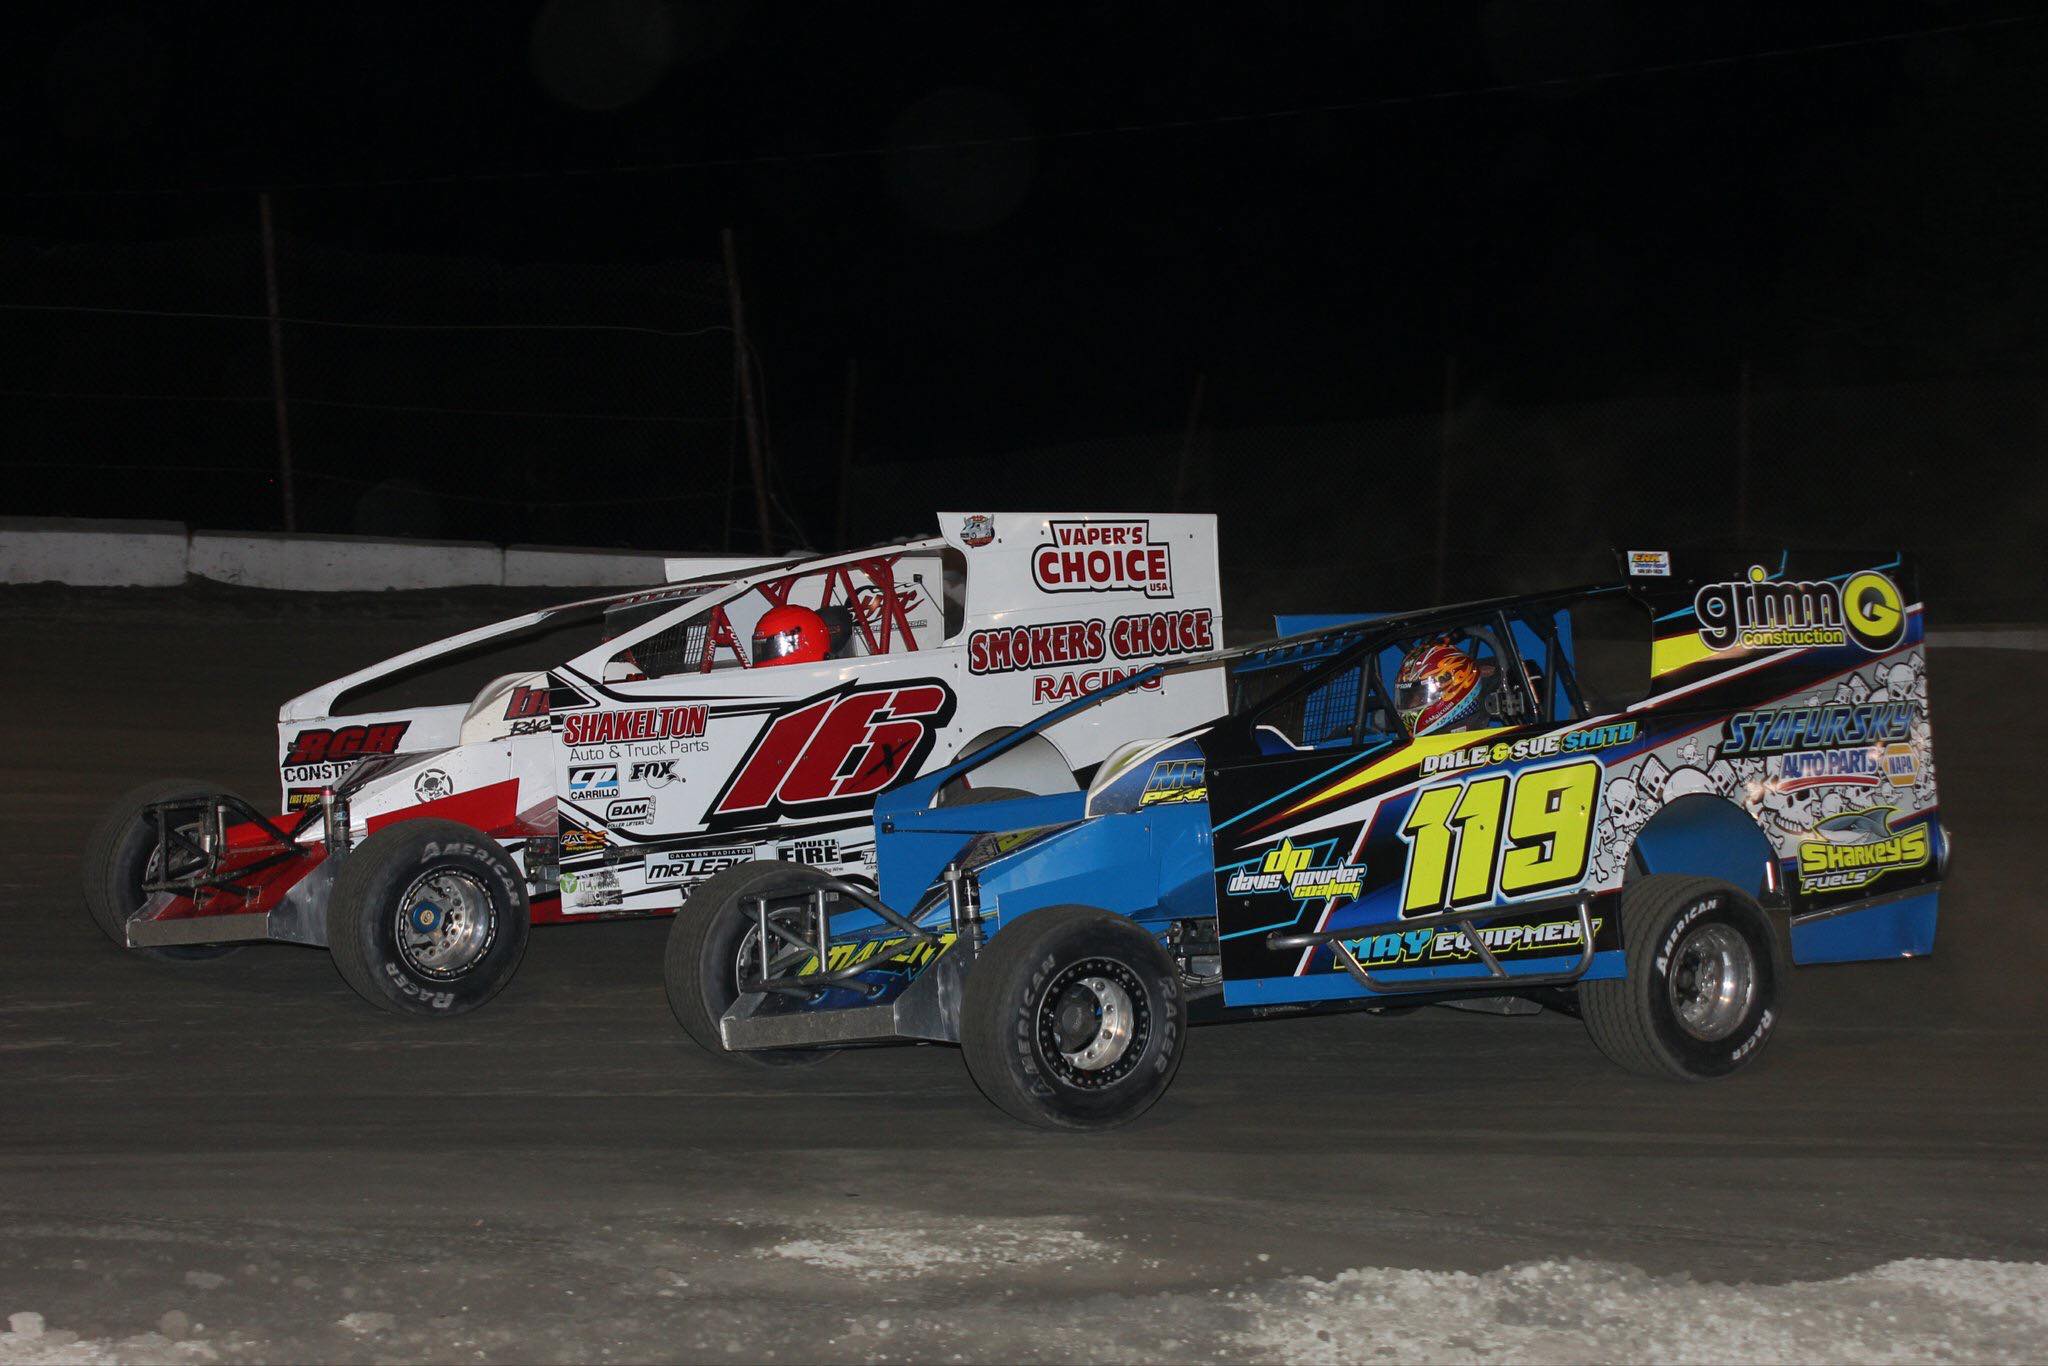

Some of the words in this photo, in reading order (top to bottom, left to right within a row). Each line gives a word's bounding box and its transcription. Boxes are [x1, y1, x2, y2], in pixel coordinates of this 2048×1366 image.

[1059, 526, 1142, 546] VAPER'S
[1038, 549, 1167, 584] CHOICE
[1150, 582, 1168, 592] USA
[970, 620, 1105, 674] SMOKERS
[1112, 610, 1212, 657] CHOICE
[1742, 629, 1845, 647] construction
[1034, 665, 1162, 702] RACING
[563, 704, 709, 746] SHAKELTON
[1722, 702, 1918, 752] STAFURSKY
[570, 748, 604, 761] Auto
[609, 745, 621, 759] &
[625, 742, 666, 757] Truck
[670, 740, 709, 753] Parts
[1421, 746, 1489, 775] DALE
[1491, 743, 1511, 763] &
[1511, 736, 1561, 759] SUE
[1562, 723, 1637, 750] SMITH
[1781, 751, 1824, 778] AUTO
[1827, 748, 1877, 775] PARTS
[1888, 755, 1913, 775] NAPA
[630, 761, 676, 780] FOX
[571, 788, 618, 799] CARRILLO
[612, 804, 647, 817] BAM
[711, 848, 753, 857] RADIATOR
[778, 846, 839, 864] FIRE
[794, 839, 836, 848] MULTI
[1401, 760, 1601, 918] 119
[421, 842, 521, 907] AMERICAN
[1263, 838, 1313, 884] dp
[1341, 928, 1433, 961] MAY
[1434, 919, 1601, 956] EQUIPMENT
[1656, 899, 1717, 977] AMERICAN
[386, 962, 455, 1009] RACER
[1732, 1009, 1774, 1061] RACER
